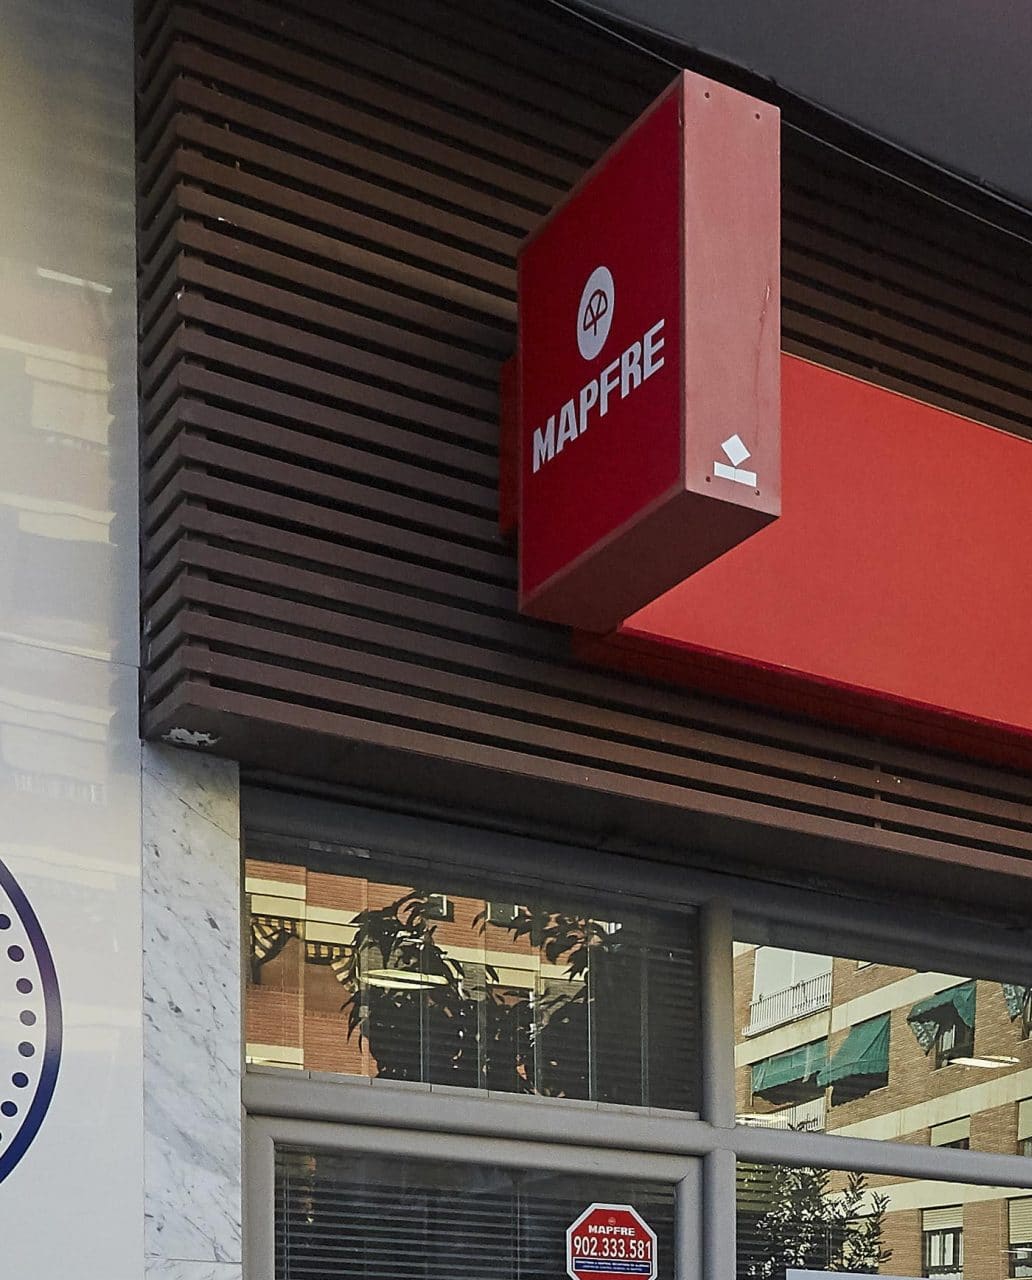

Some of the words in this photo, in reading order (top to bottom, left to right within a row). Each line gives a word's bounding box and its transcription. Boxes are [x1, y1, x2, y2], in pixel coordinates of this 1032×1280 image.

[533, 318, 665, 474] MAPFRE
[588, 1225, 636, 1236] MAPFRE
[573, 1236, 651, 1259] 902.333.581
